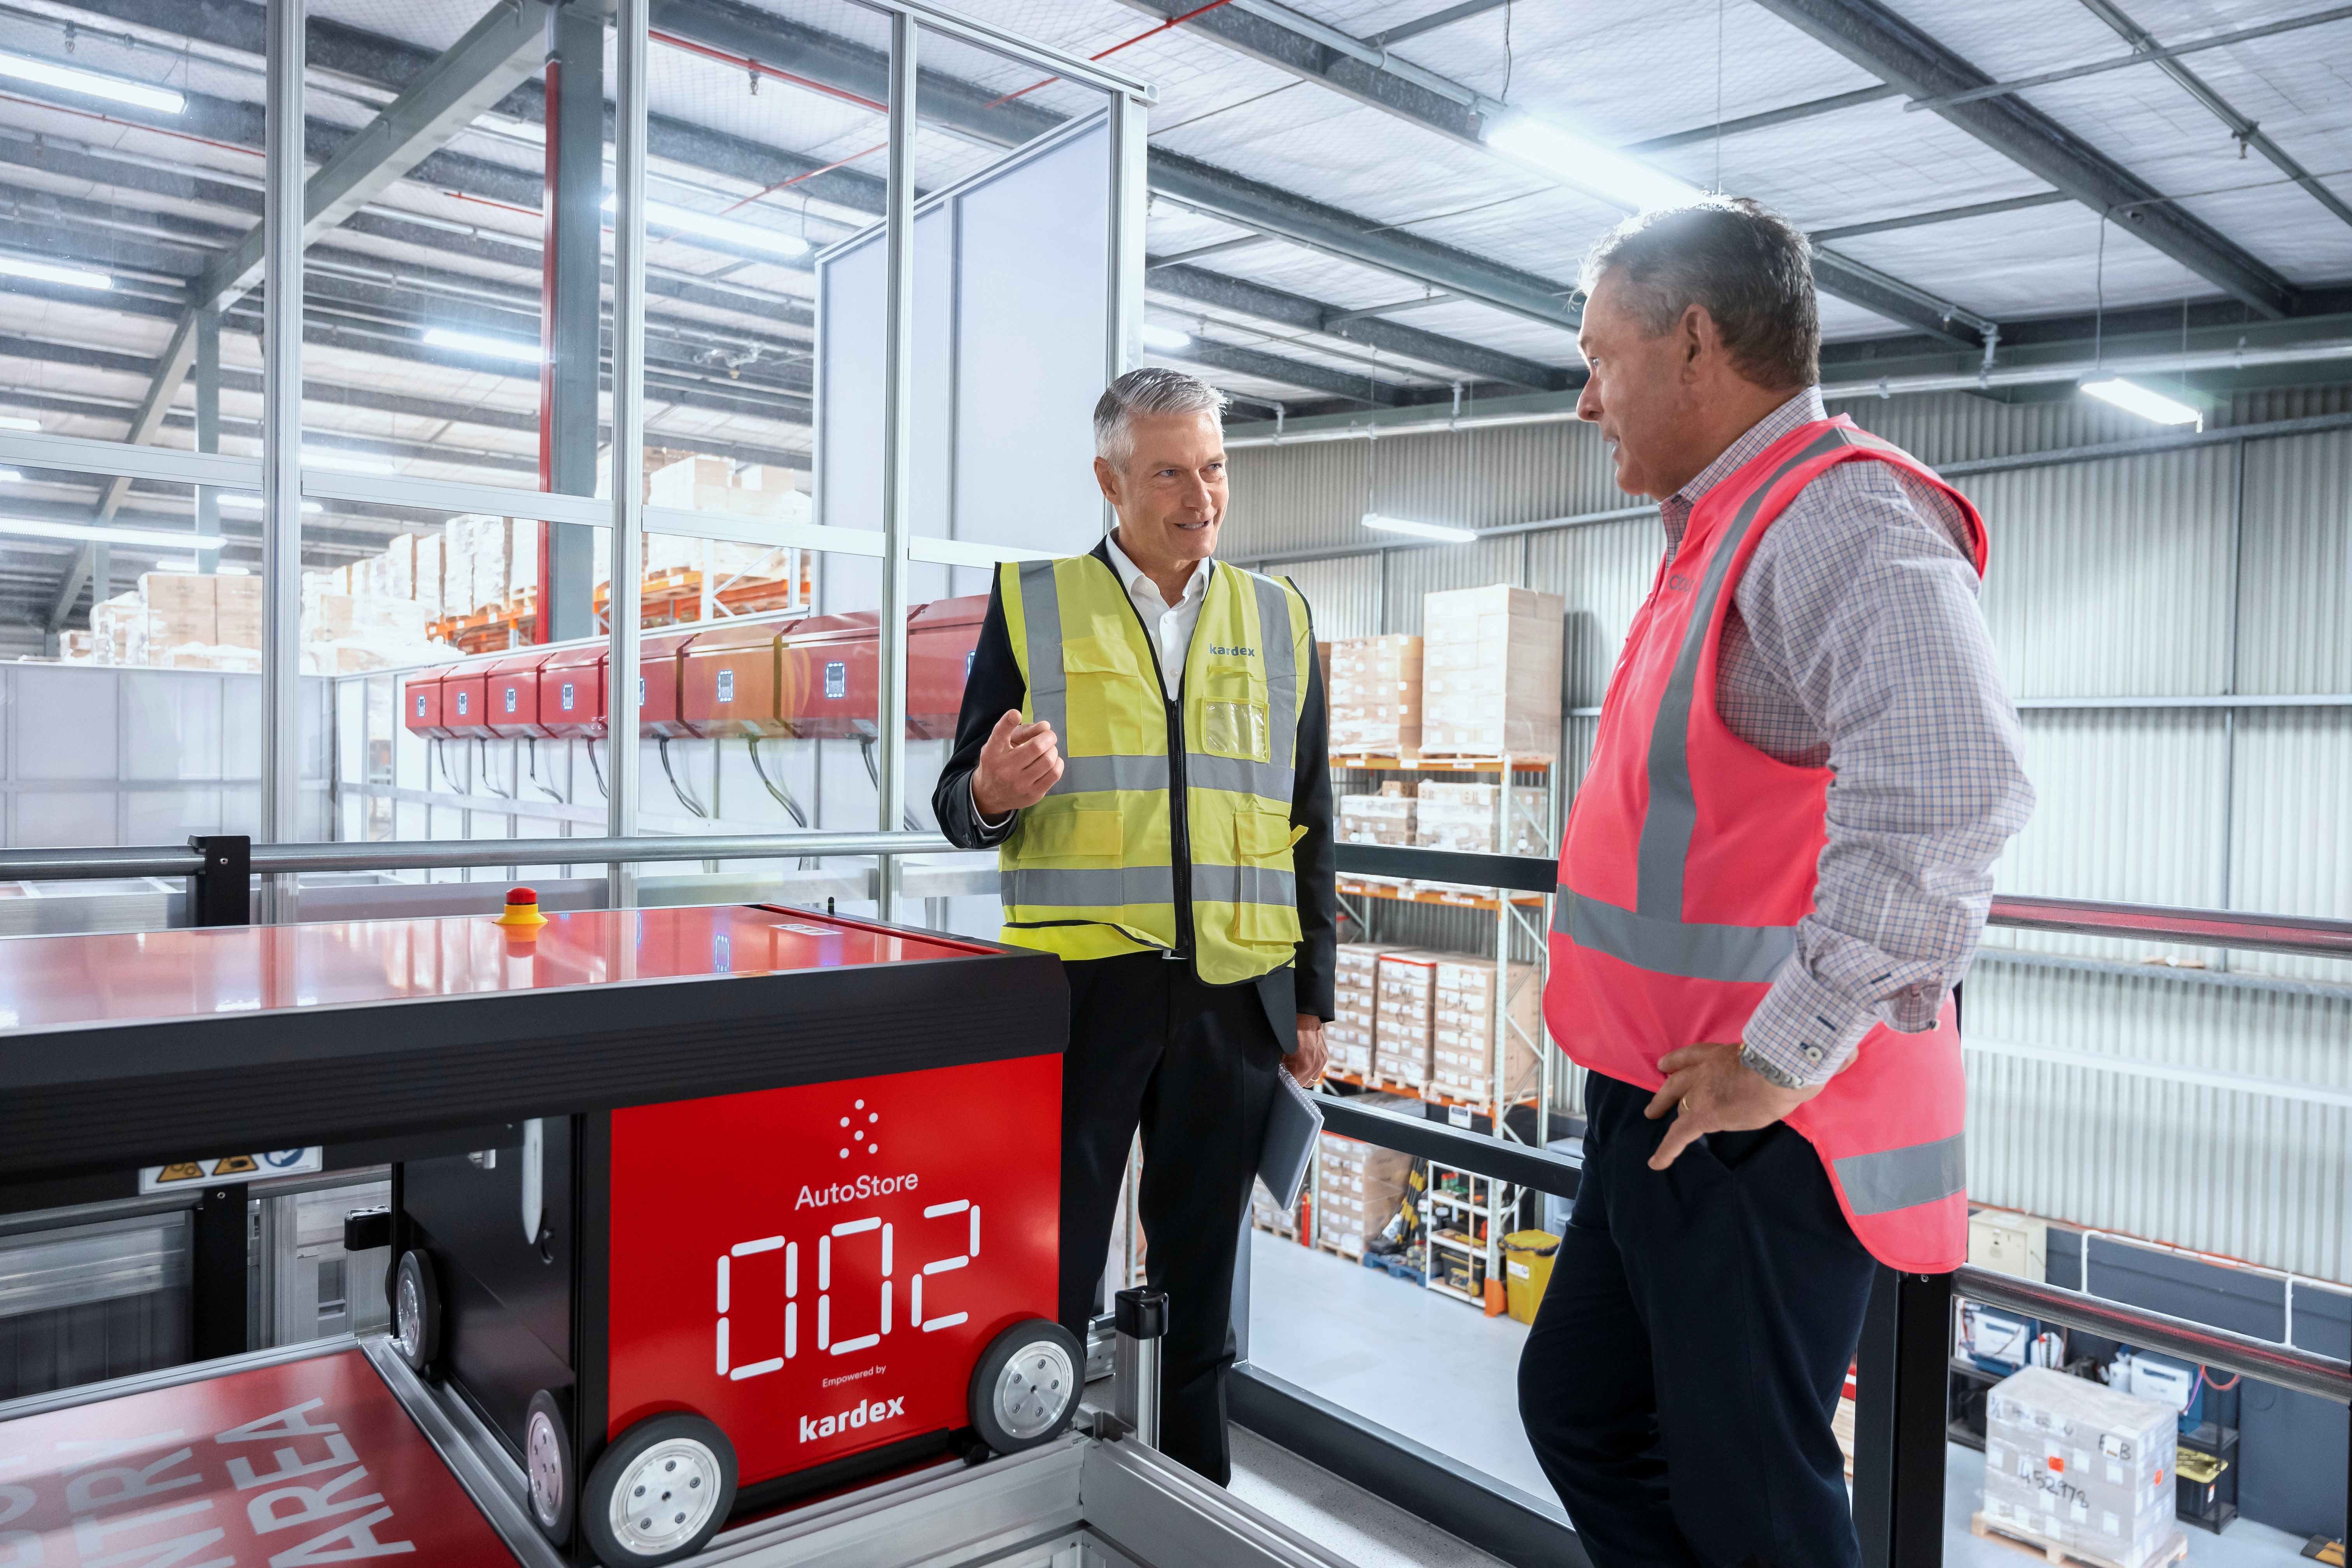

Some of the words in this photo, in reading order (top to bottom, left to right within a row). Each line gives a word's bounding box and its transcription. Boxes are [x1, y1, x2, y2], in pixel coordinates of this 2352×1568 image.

[1209, 643, 1255, 657] kardex
[795, 1173, 918, 1210] AutoStore
[716, 1199, 980, 1381] 002
[822, 1366, 874, 1387] Empowered
[876, 1365, 886, 1374] by
[800, 1396, 905, 1443] kardex
[215, 1397, 417, 1568] AREA
